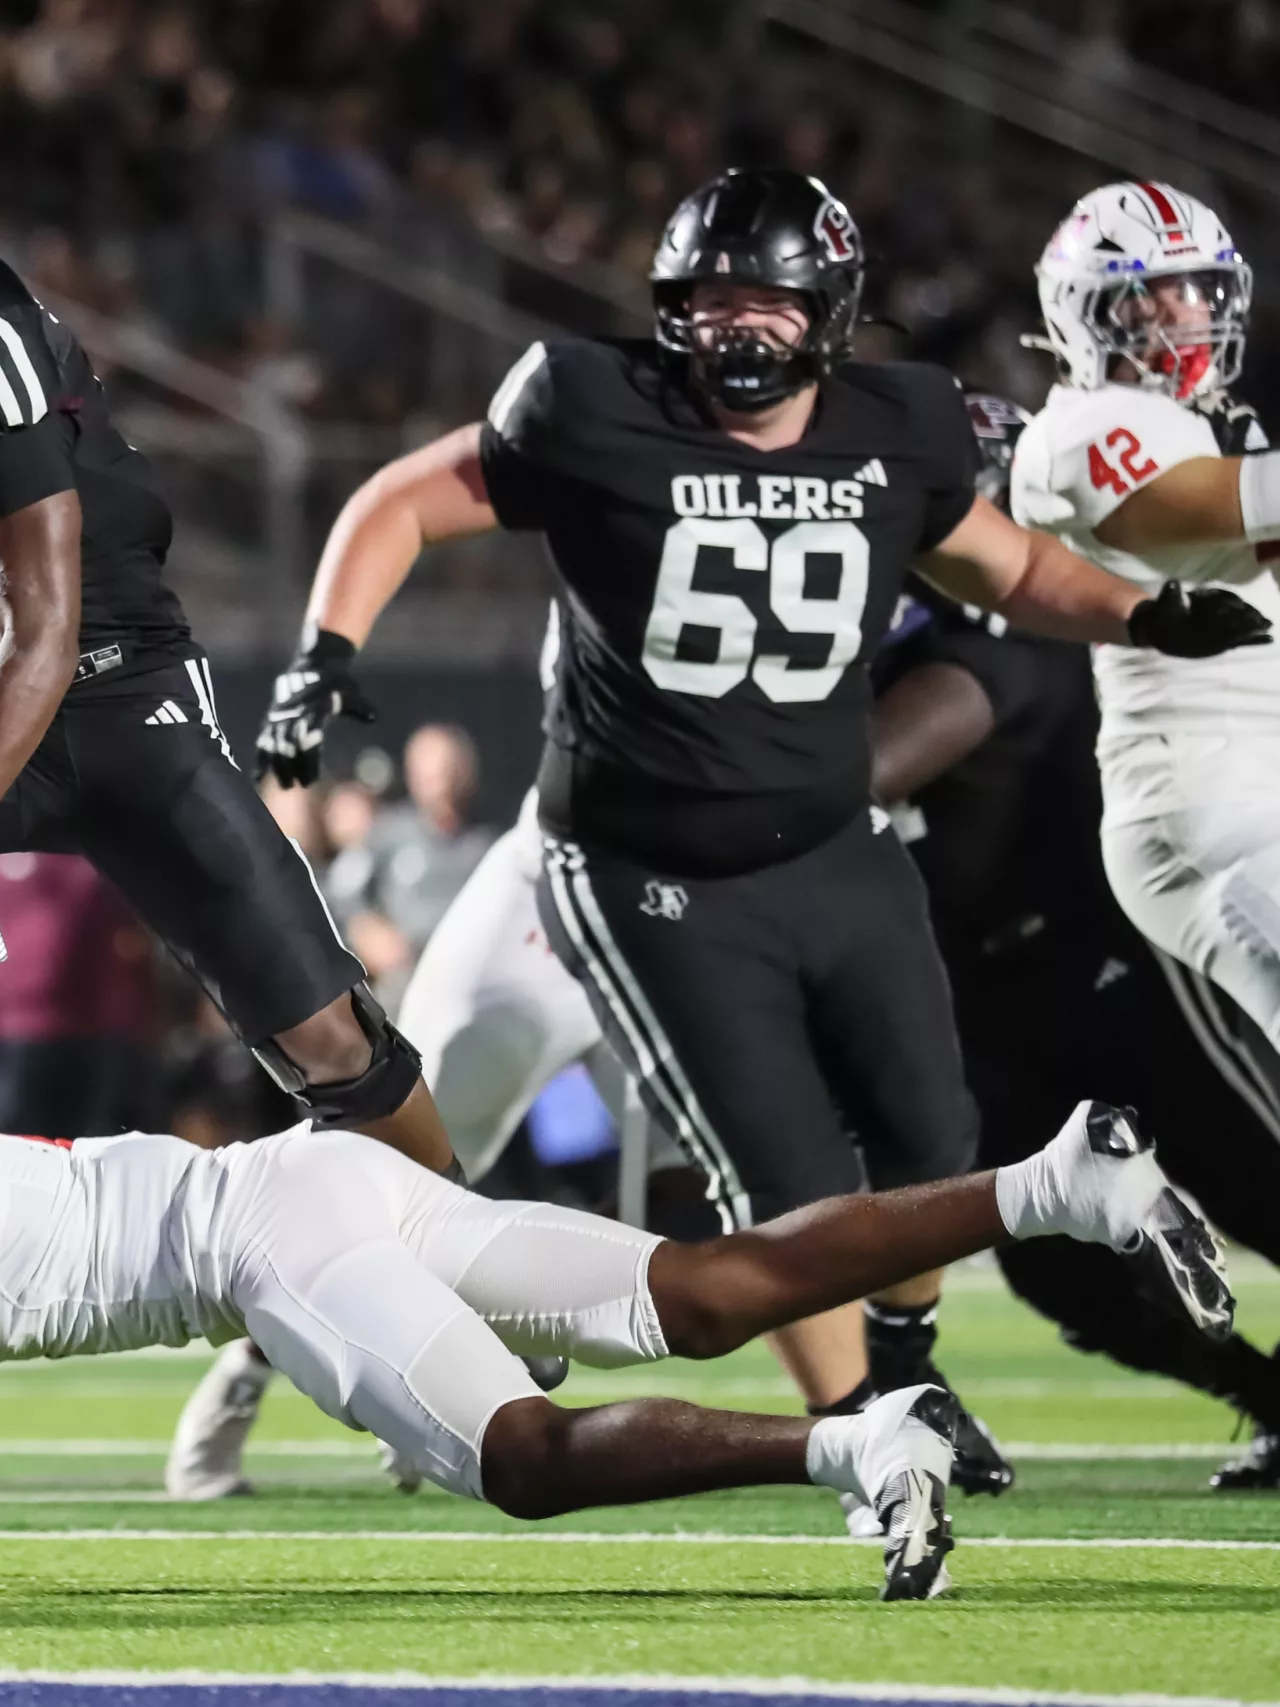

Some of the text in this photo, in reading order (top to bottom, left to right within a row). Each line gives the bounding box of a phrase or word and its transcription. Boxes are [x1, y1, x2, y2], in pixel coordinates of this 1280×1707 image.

[813, 198, 858, 262] P
[1087, 427, 1159, 496] 42
[671, 473, 865, 520] OILERS
[641, 516, 871, 703] 69
